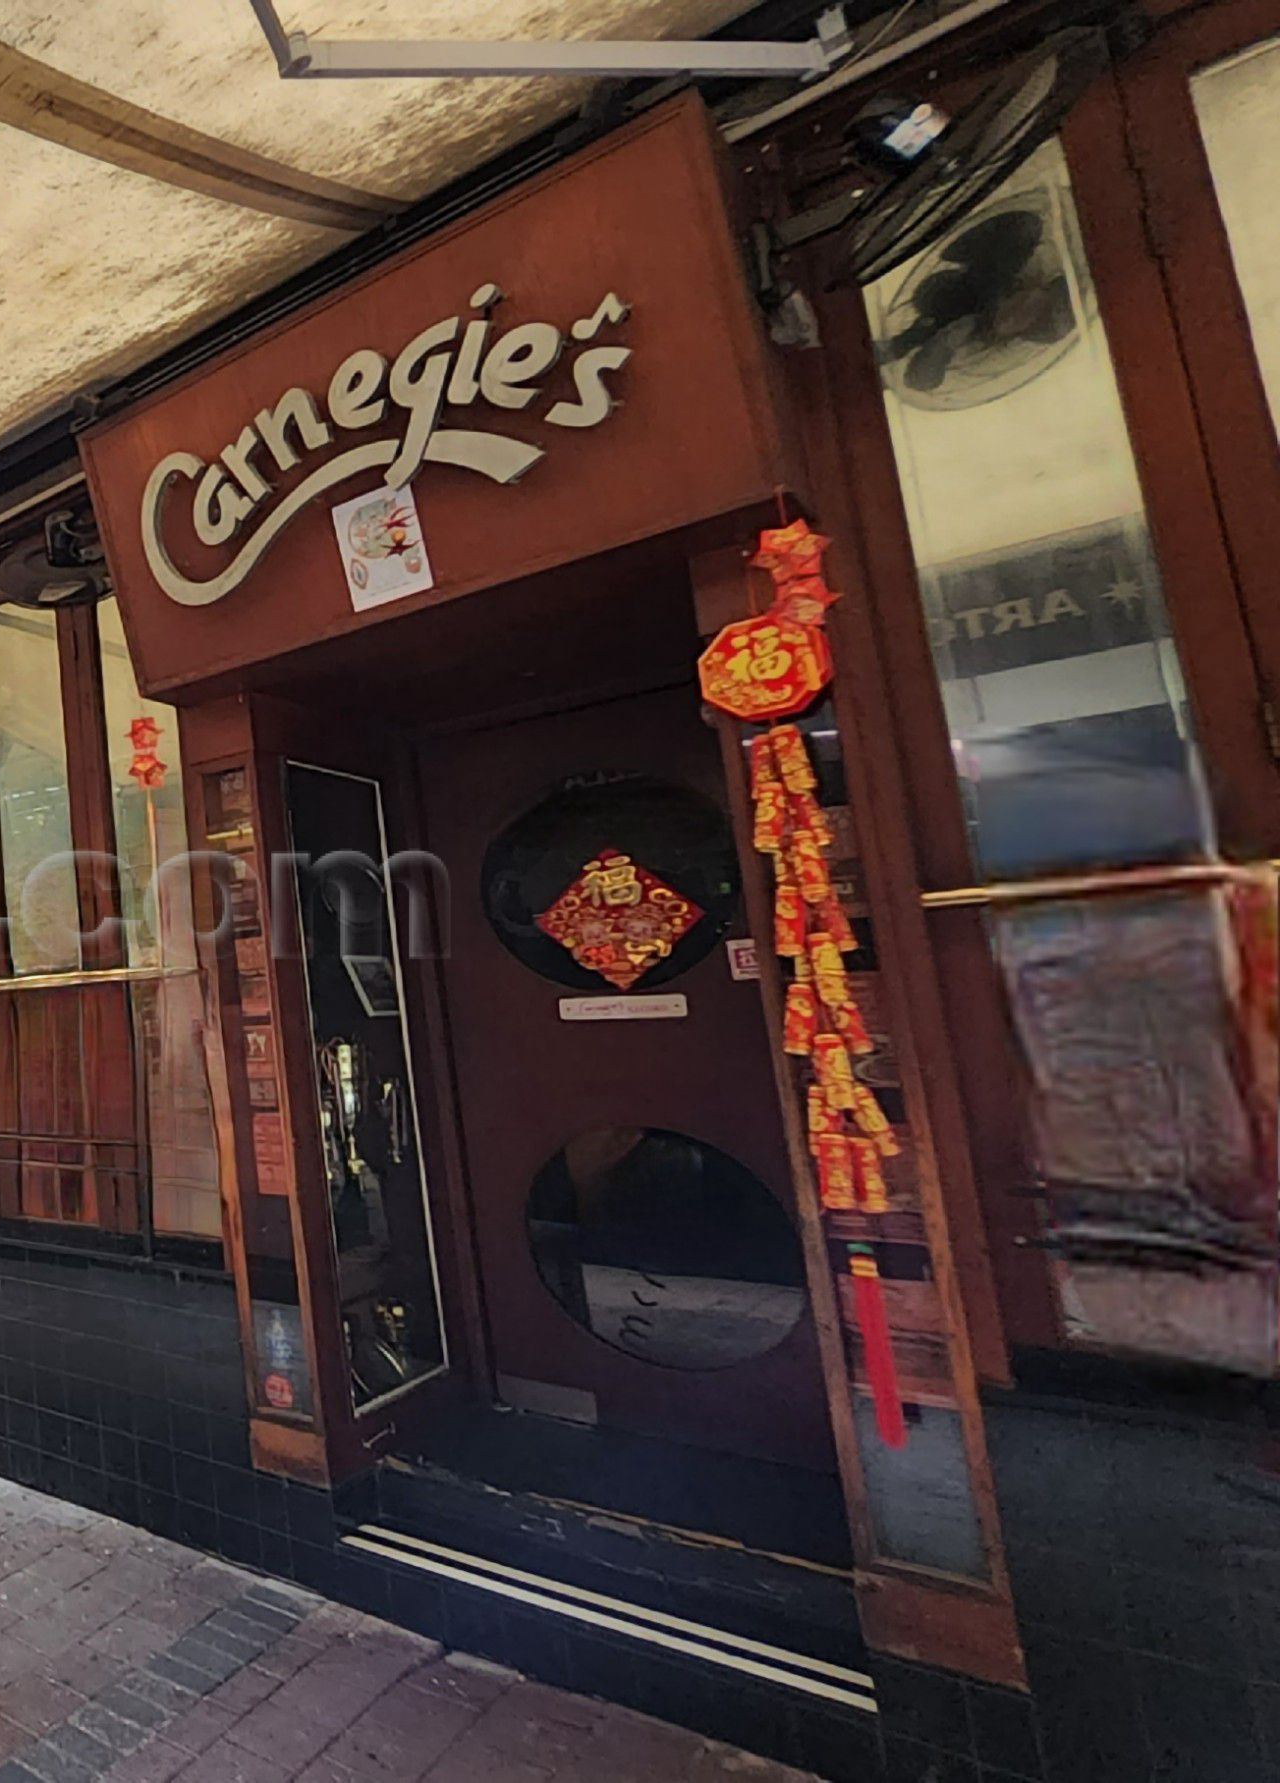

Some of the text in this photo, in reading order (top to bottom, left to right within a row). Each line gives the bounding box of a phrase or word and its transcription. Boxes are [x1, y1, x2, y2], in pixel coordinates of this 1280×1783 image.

[141, 284, 633, 606] Carnegie's
[725, 625, 793, 684] 福
[582, 855, 643, 907] 福
